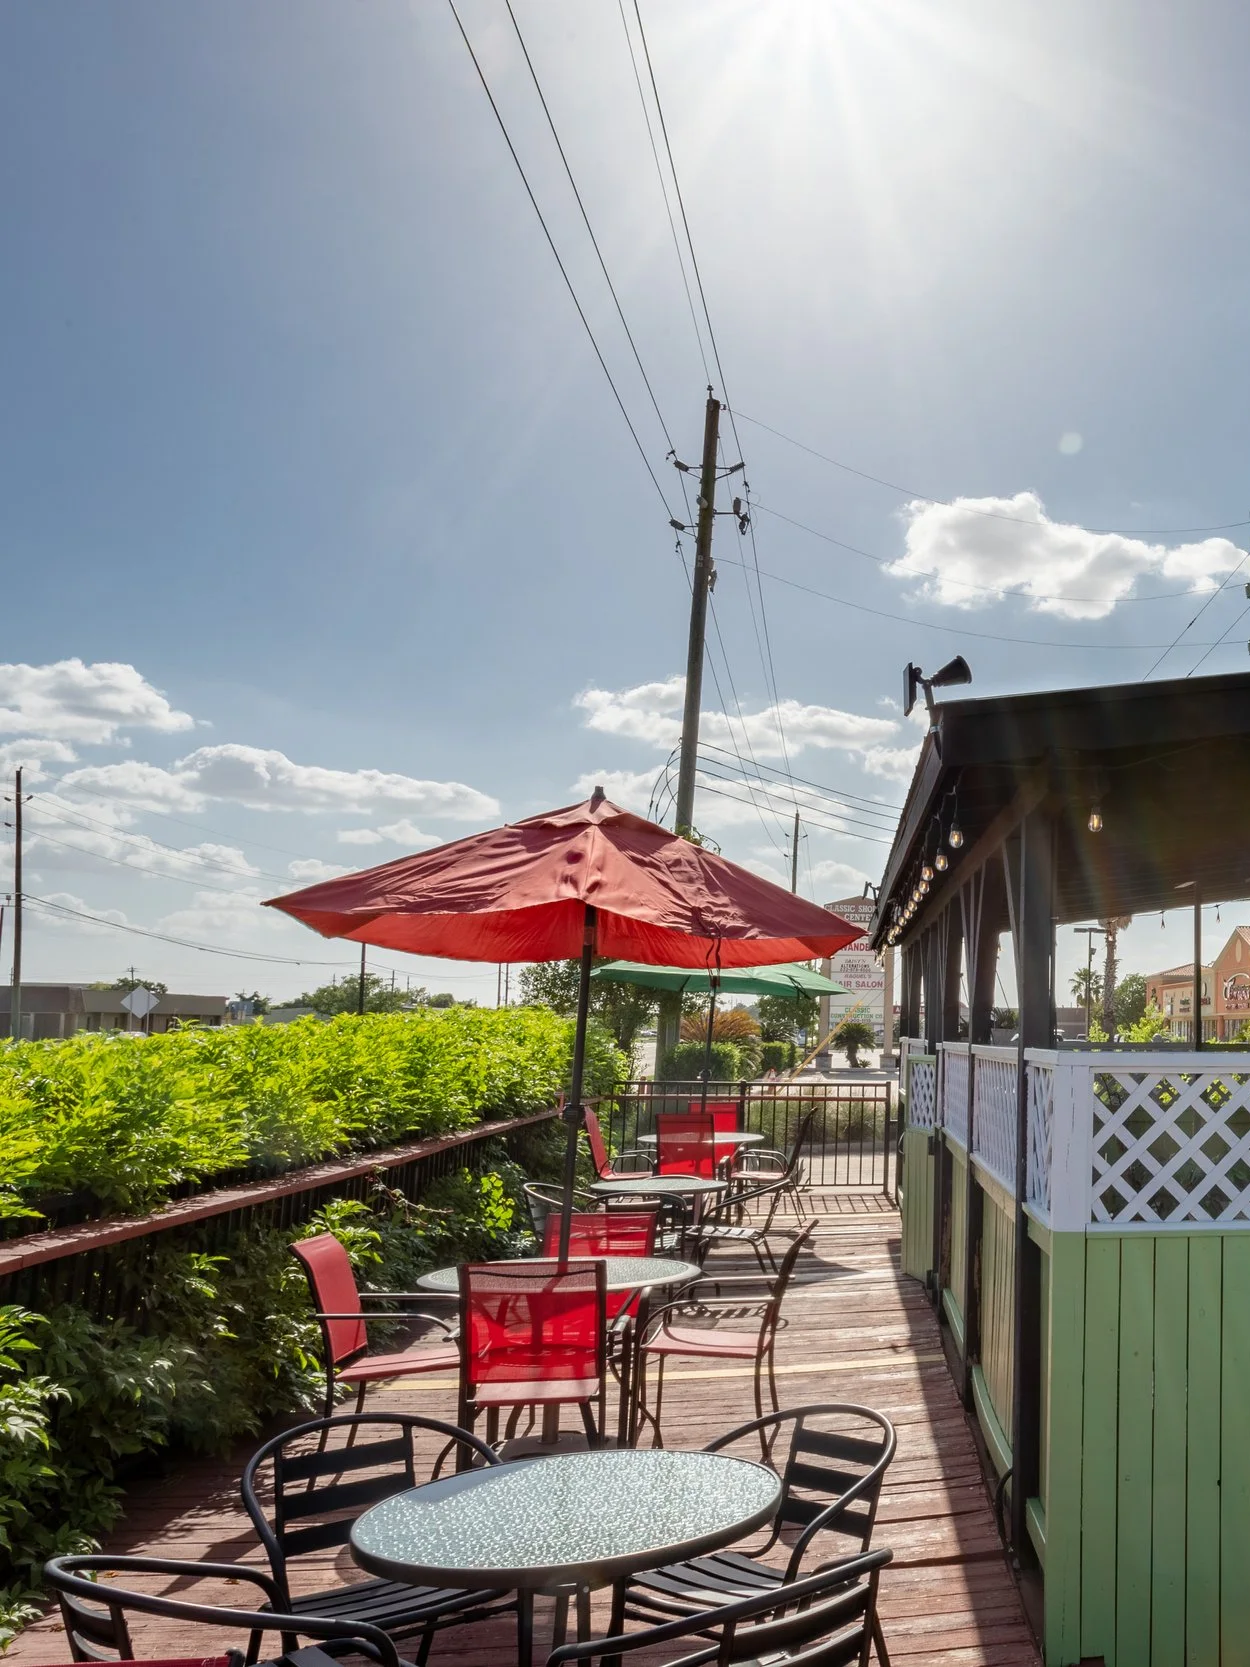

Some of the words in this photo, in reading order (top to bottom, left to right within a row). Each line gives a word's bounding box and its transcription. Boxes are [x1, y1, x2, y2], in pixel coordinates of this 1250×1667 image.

[824, 904, 855, 912] CLASSIC
[844, 913, 873, 921] CENTE
[835, 980, 852, 988] AIR
[855, 980, 883, 988] SALON
